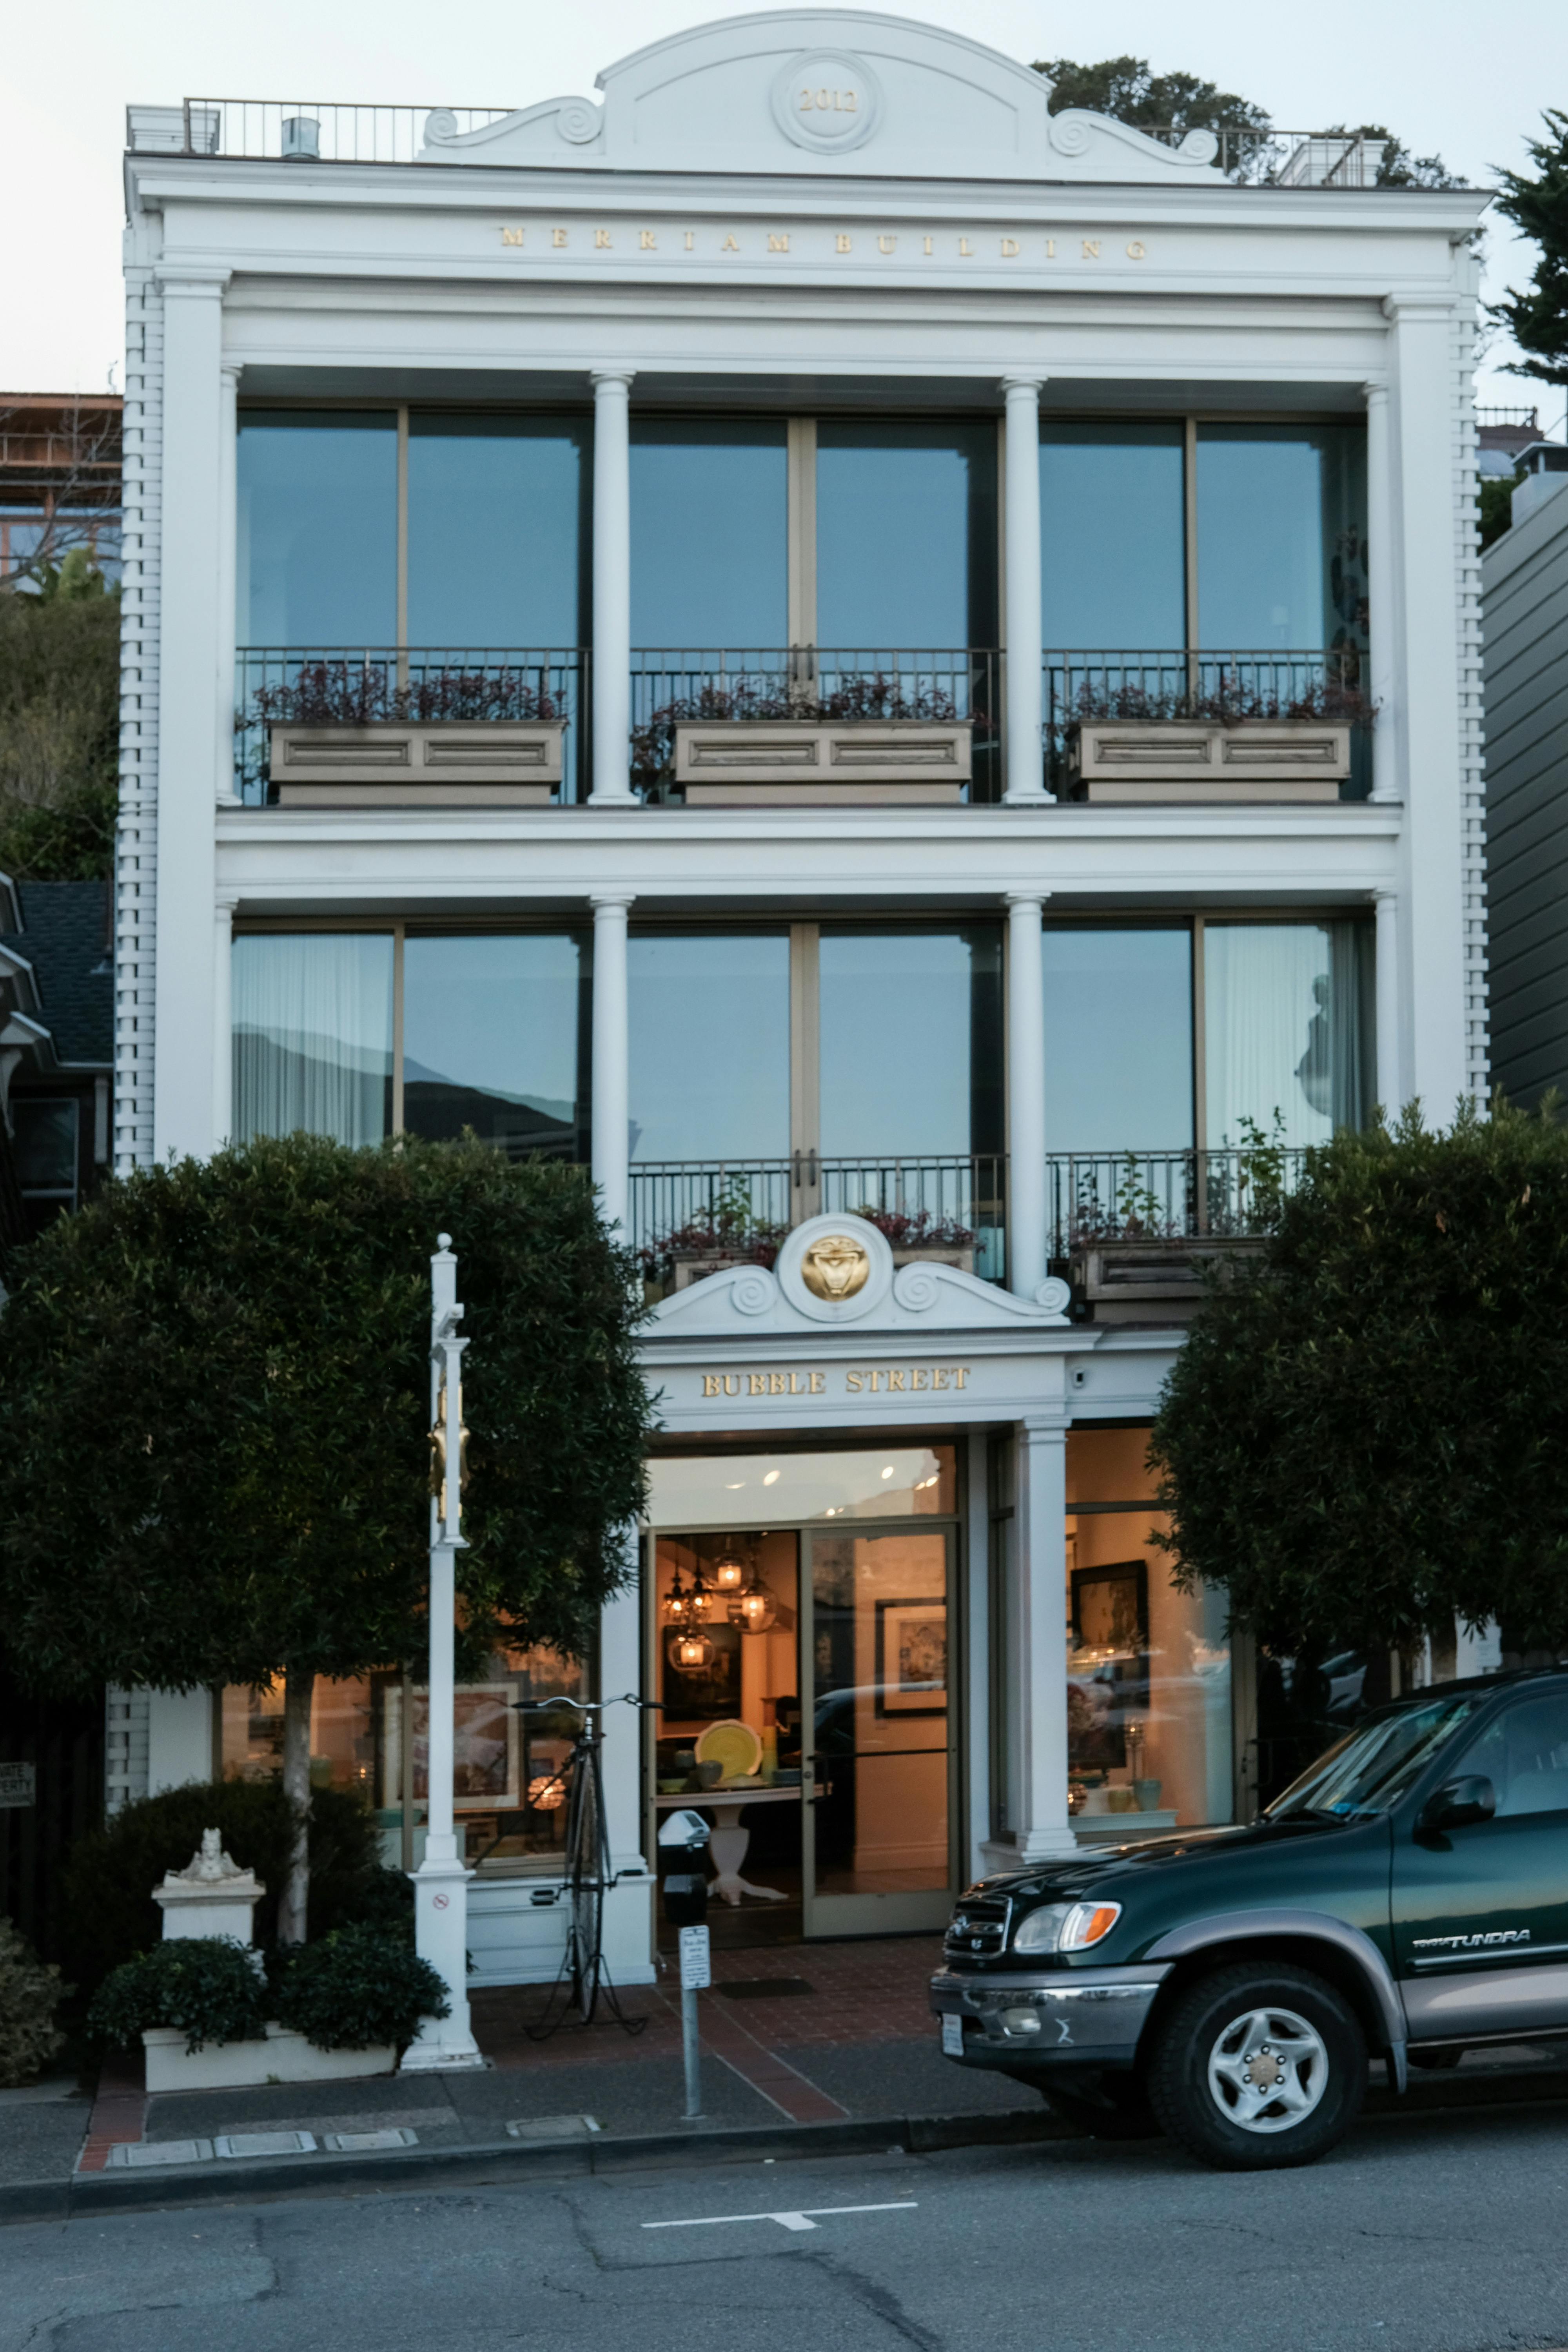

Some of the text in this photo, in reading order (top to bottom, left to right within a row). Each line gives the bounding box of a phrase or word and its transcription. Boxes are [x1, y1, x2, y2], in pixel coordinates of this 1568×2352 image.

[800, 89, 858, 112] 2012
[502, 227, 1146, 260] MERRIAM BUILDING
[702, 1368, 970, 1397] BUBBLE STREET
[1449, 1929, 1530, 1948] TUNDRA
